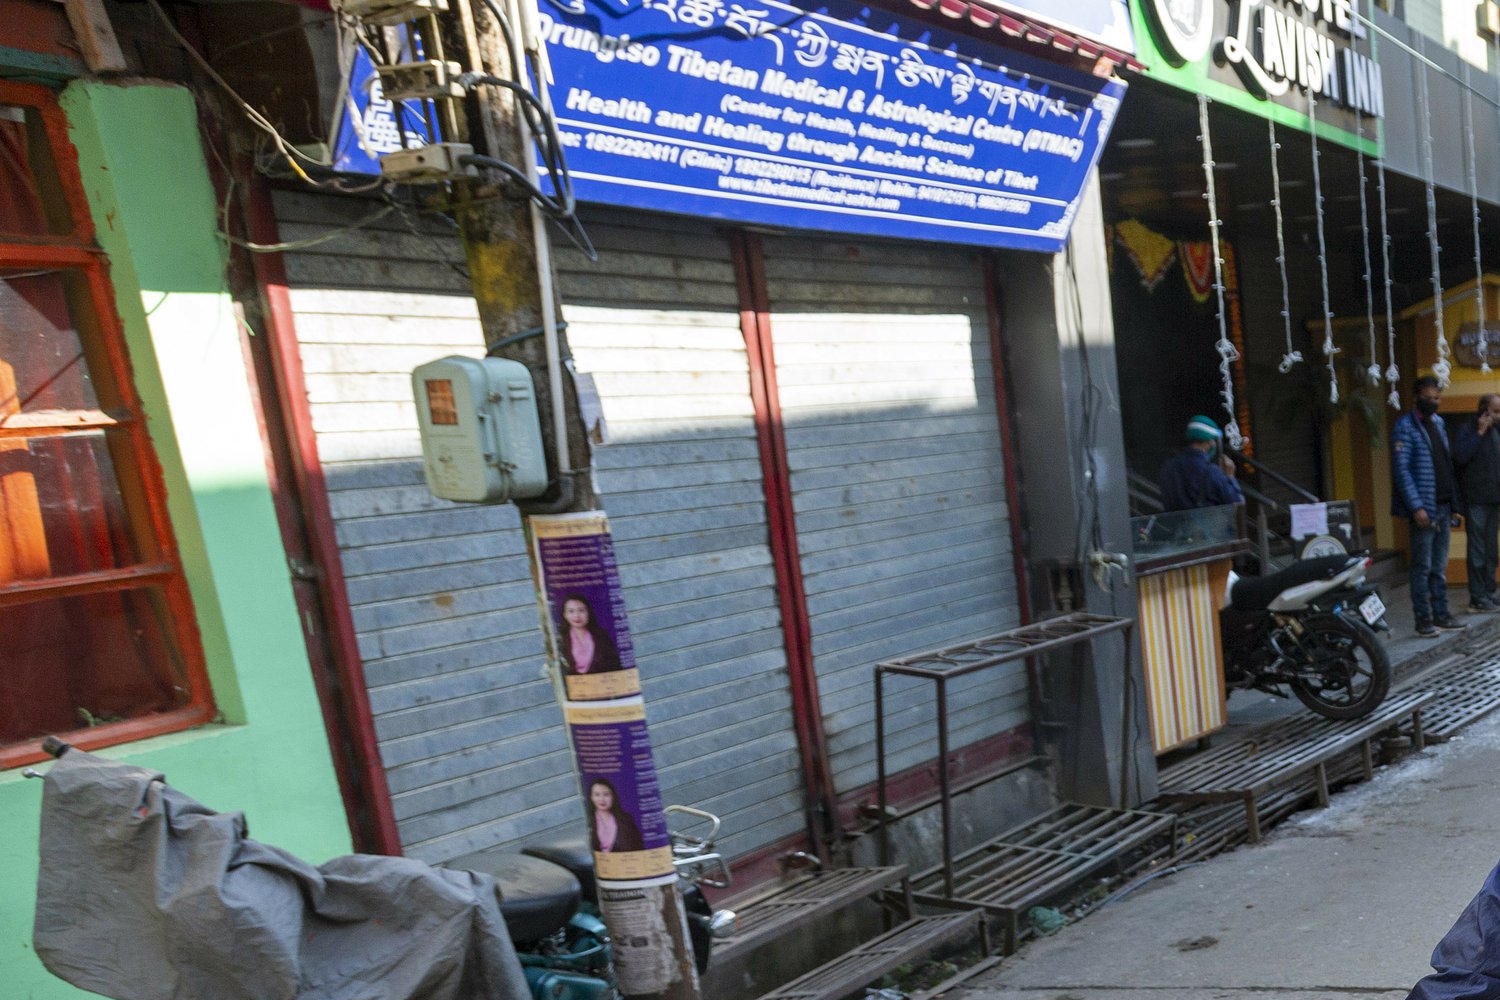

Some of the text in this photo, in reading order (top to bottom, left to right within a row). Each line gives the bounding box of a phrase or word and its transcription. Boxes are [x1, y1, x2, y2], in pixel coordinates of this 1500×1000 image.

[538, 12, 1083, 162] Drungtso Tibetan Medical & Astrological Centre (DTMAC)
[1343, 47, 1384, 118] INN
[566, 88, 1038, 191] Health and Healing through Ancient Science of Tibet
[680, 149, 732, 174] (Clinic)
[720, 94, 974, 159] (Center for Health, Healing & Success)
